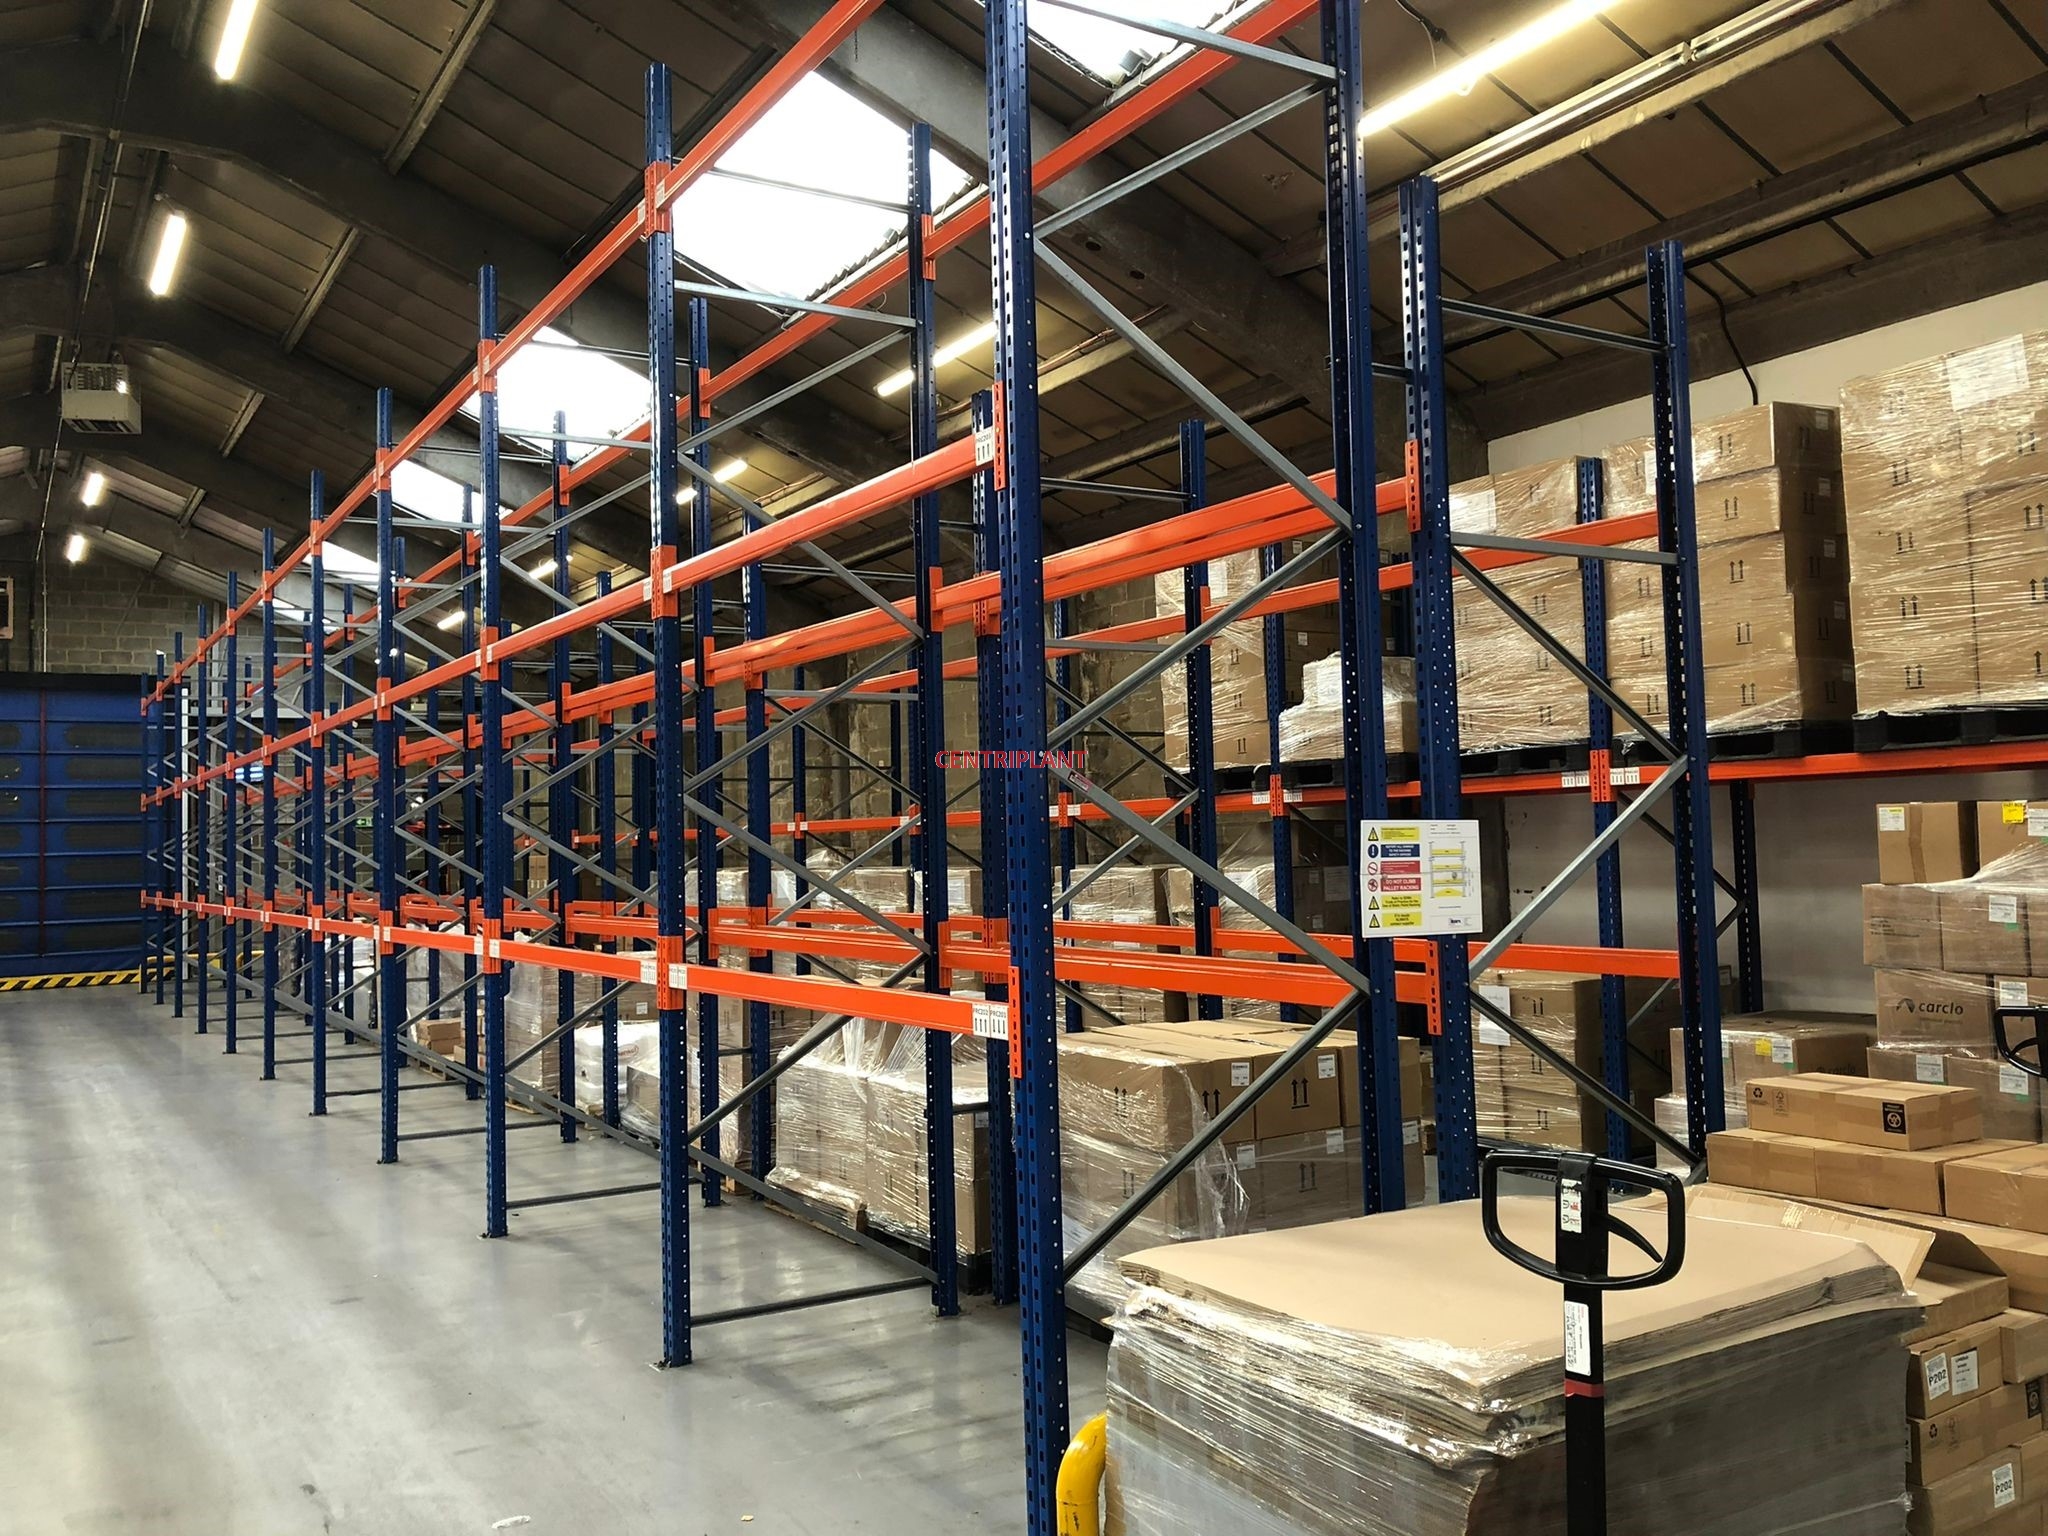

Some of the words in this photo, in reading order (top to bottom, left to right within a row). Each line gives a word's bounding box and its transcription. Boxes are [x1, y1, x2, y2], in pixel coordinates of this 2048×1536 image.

[1919, 1002, 1963, 1015] carclo
[1929, 1369, 1946, 1386] P202
[1995, 1479, 2013, 1494] P202
